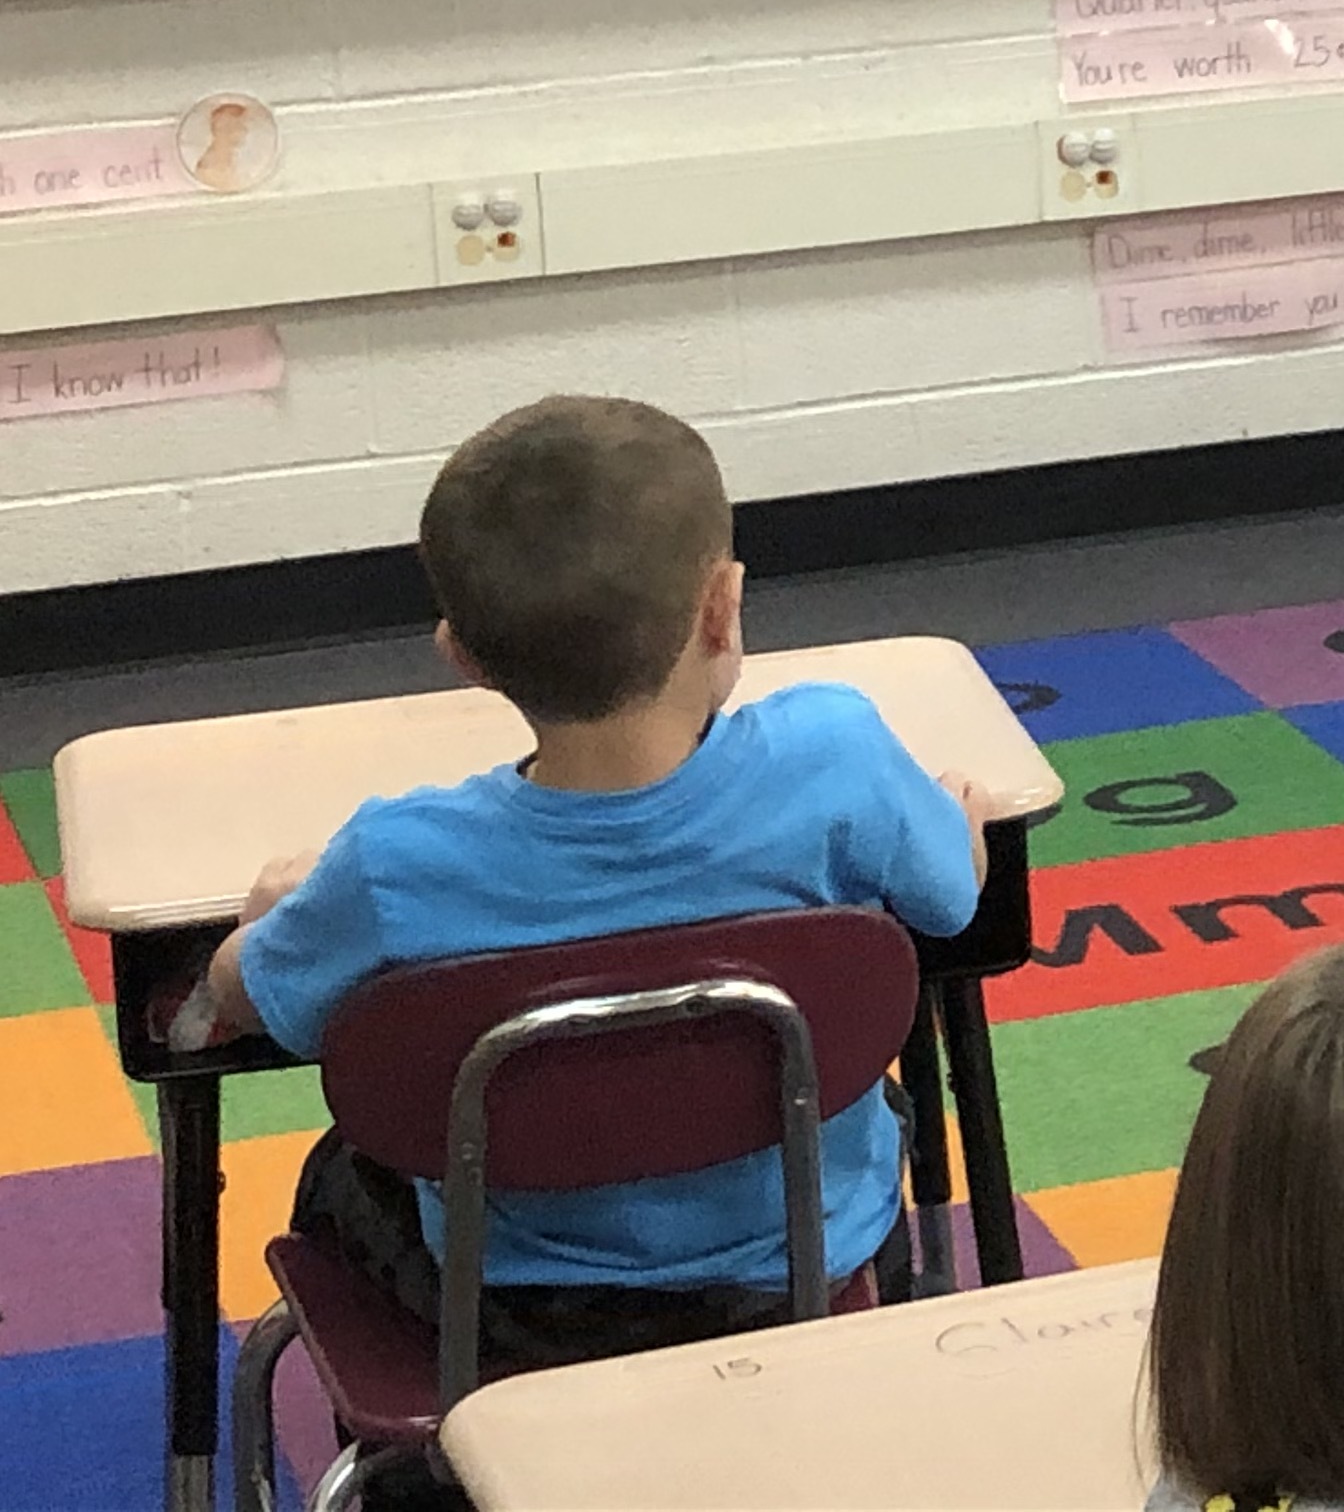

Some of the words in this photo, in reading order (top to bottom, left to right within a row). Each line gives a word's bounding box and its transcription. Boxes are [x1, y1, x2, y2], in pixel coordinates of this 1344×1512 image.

[1173, 40, 1252, 79] worth
[34, 168, 82, 194] one
[103, 145, 163, 188] cent
[1120, 296, 1141, 333] I
[1160, 290, 1280, 329] remember
[52, 360, 124, 401] know
[711, 1356, 763, 1381] 15
